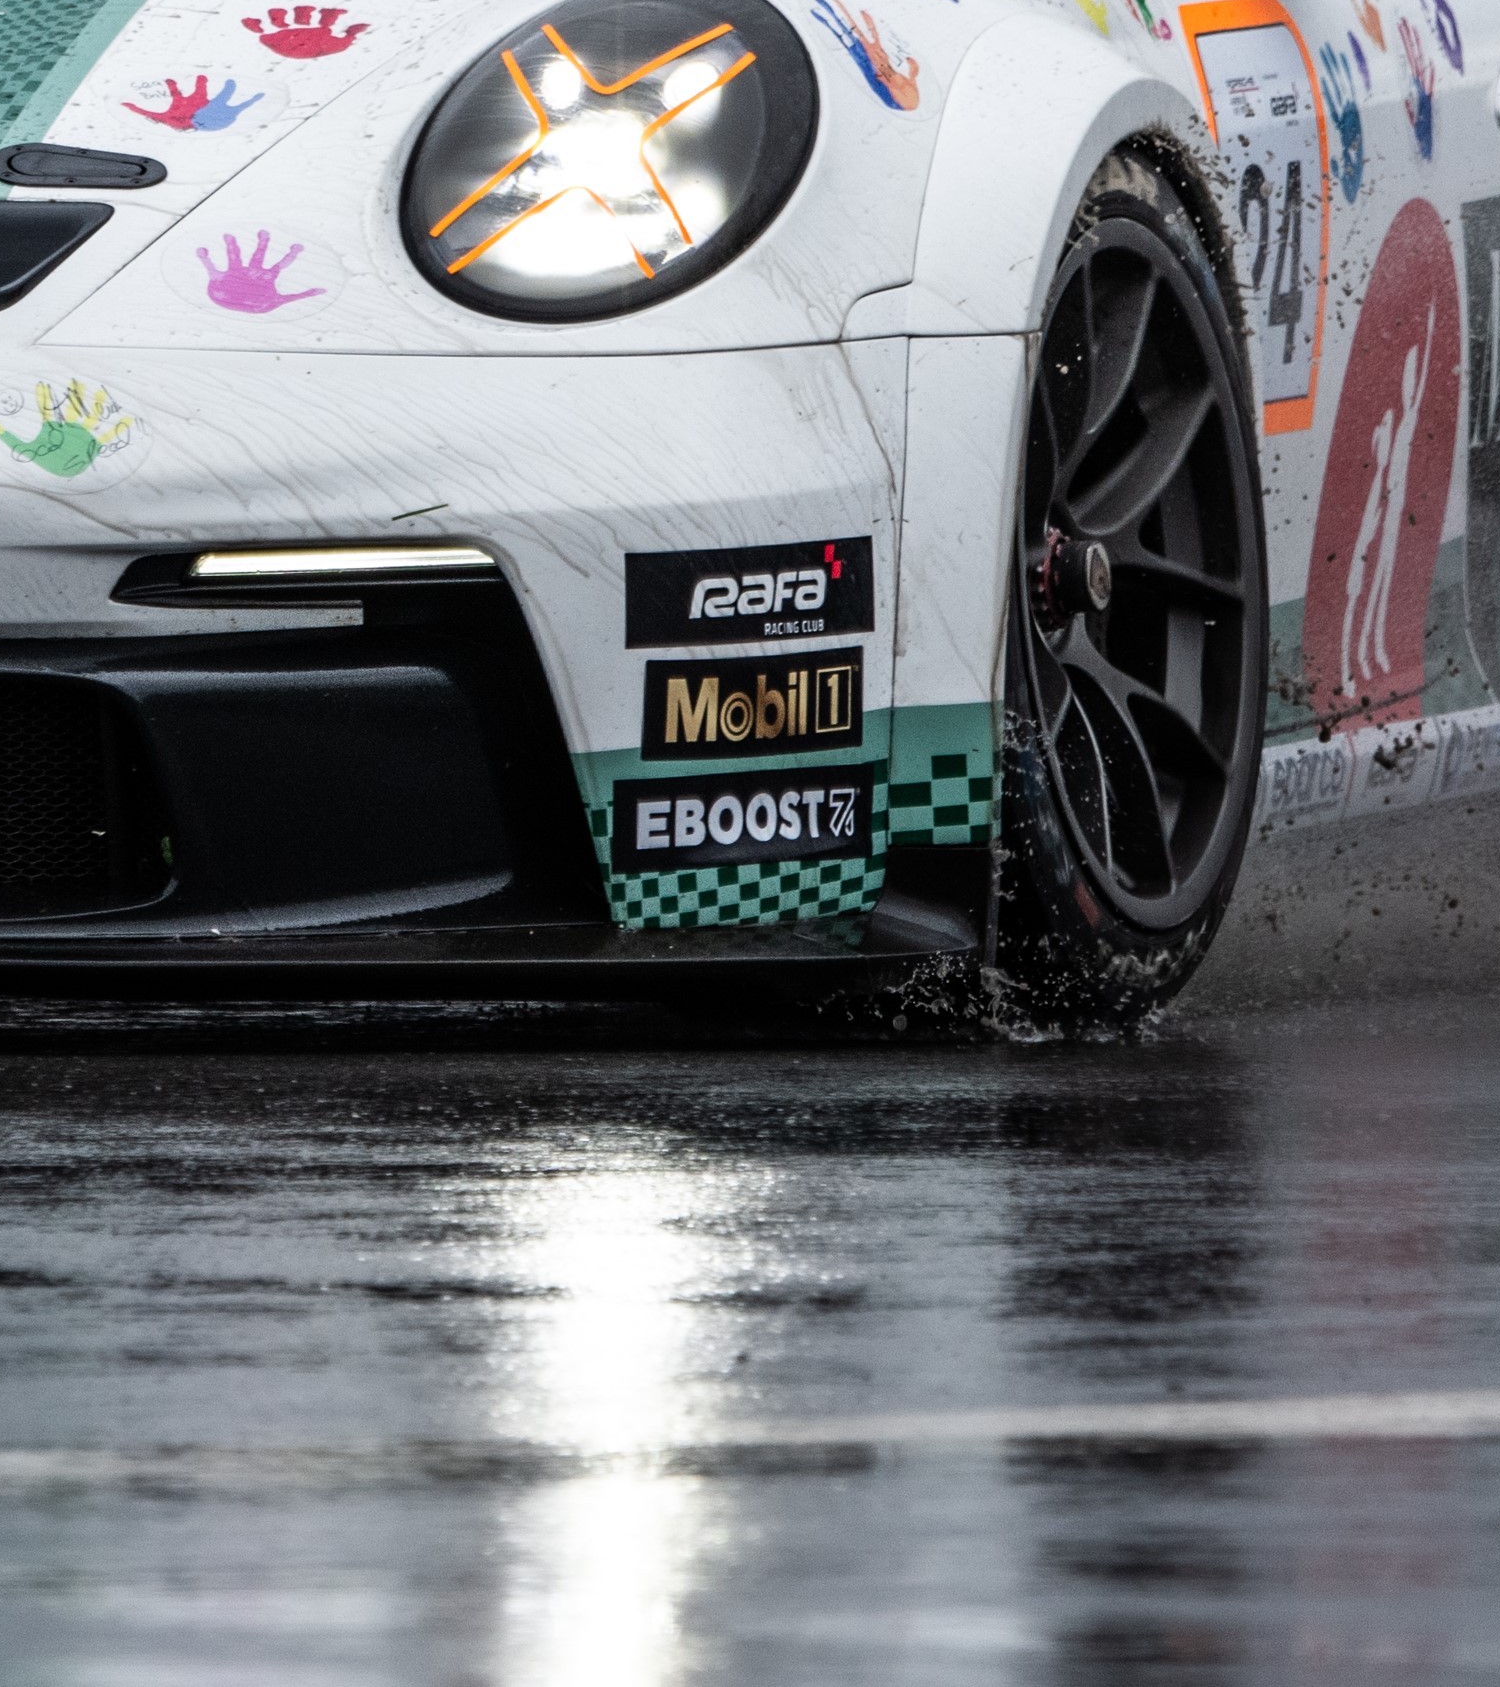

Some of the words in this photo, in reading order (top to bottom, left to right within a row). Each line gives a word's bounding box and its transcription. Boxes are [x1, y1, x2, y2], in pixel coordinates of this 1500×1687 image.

[1238, 160, 1304, 365] 24
[763, 620, 800, 636] RACING
[801, 618, 826, 633] CLUB
[663, 669, 809, 744] Mobil
